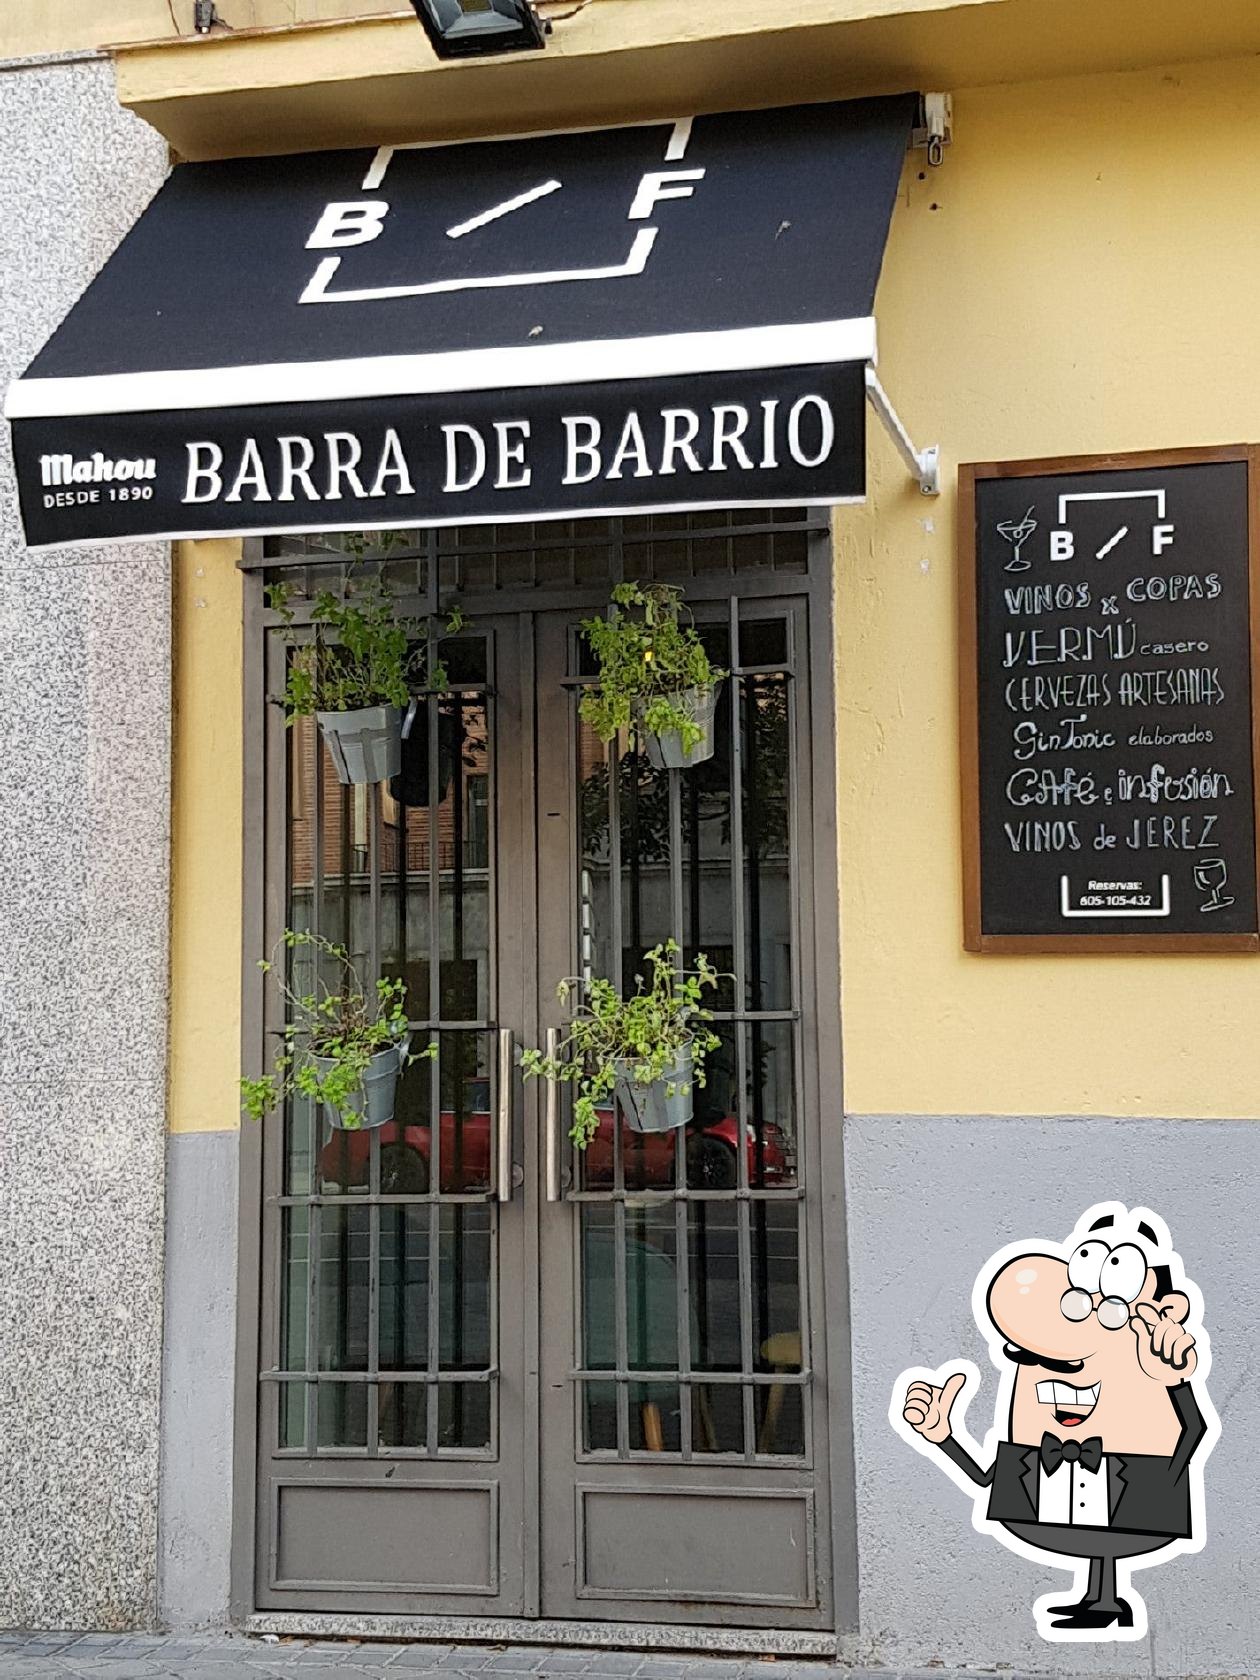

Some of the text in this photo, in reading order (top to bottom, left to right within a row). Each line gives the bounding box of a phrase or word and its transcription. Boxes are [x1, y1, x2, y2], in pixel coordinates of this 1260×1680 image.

[304, 201, 389, 250] B
[628, 168, 706, 219] F
[181, 394, 835, 505] BARRA DE BARRIO
[39, 452, 157, 486] Mahou
[43, 486, 153, 508] DESDE 1890
[1050, 531, 1074, 561] B
[1153, 525, 1174, 555] F
[1004, 582, 1091, 615] VINOS
[1126, 573, 1221, 601] COPAS
[1003, 617, 1209, 668] VERMÚ casero
[1005, 667, 1224, 711] CERVEZAS ARTESANAS
[1128, 723, 1214, 746] elaborados
[1118, 763, 1235, 803] infusión
[1004, 815, 1219, 852] VINOS de JEREZ
[1088, 880, 1142, 891] Reservas:
